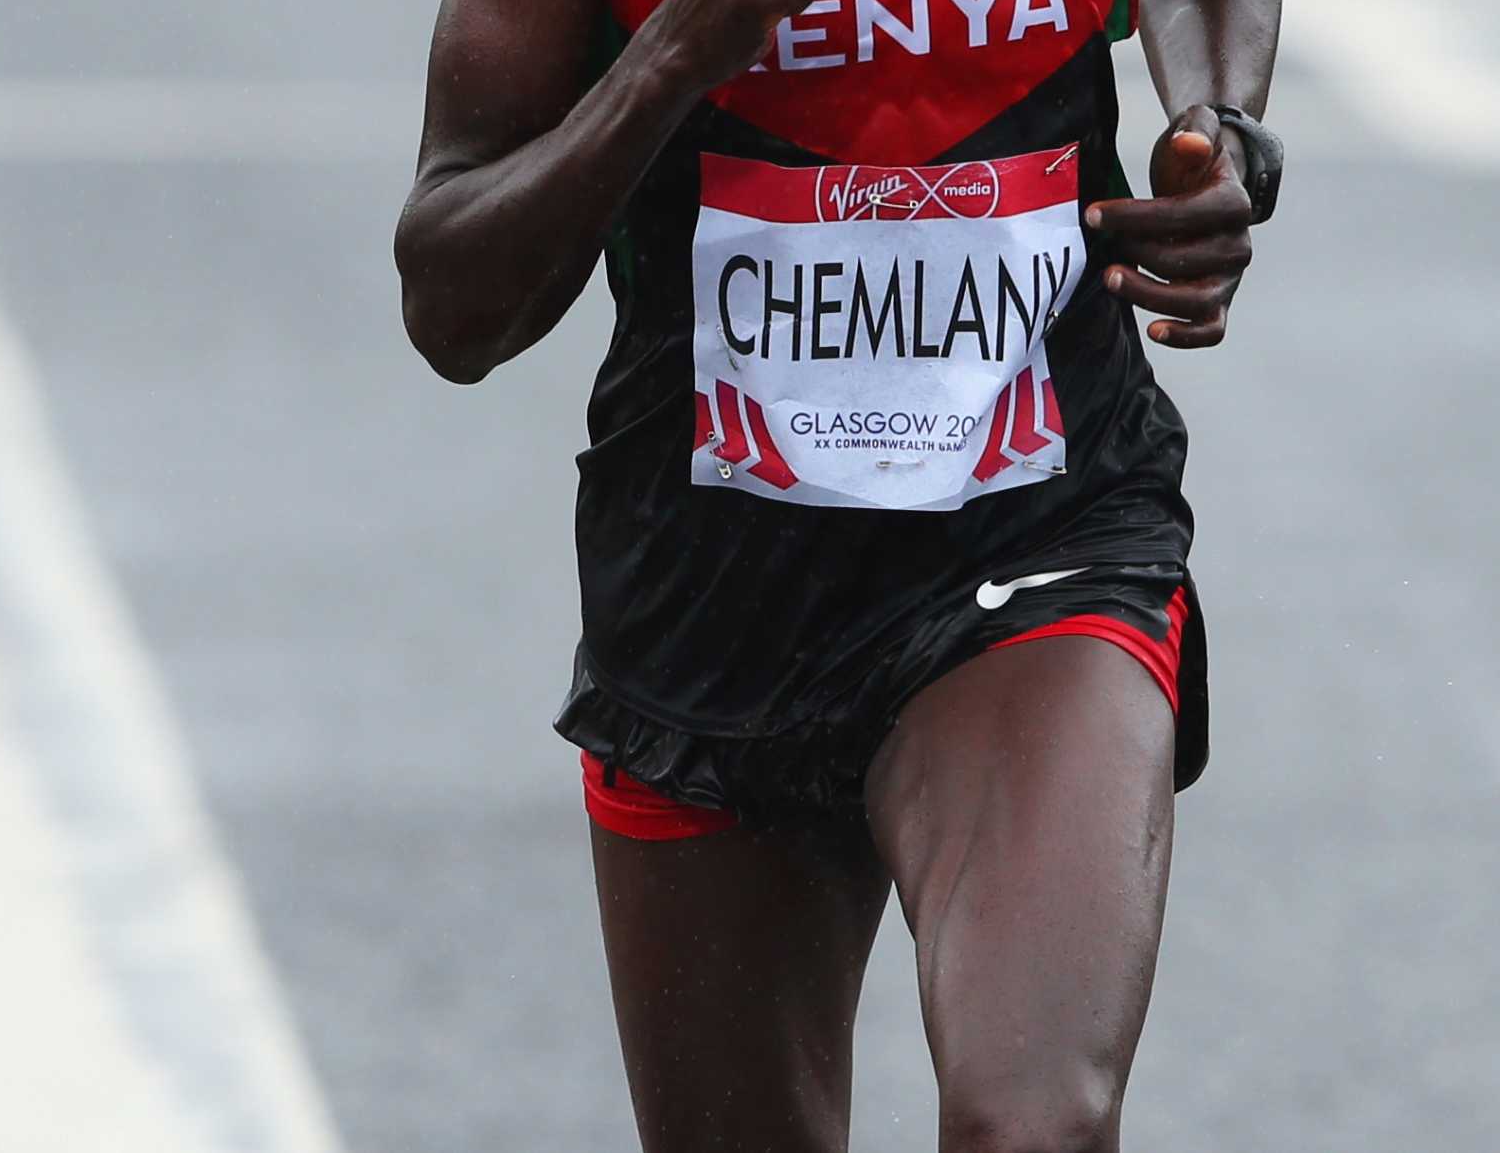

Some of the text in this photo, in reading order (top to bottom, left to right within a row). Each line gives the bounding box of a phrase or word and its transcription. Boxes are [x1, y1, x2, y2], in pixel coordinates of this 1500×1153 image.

[943, 182, 991, 197] media
[717, 245, 1070, 362] CHEMLANY
[790, 411, 938, 436] GLASGOW
[813, 439, 831, 450] XX
[835, 438, 935, 452] COMMONWEALTH
